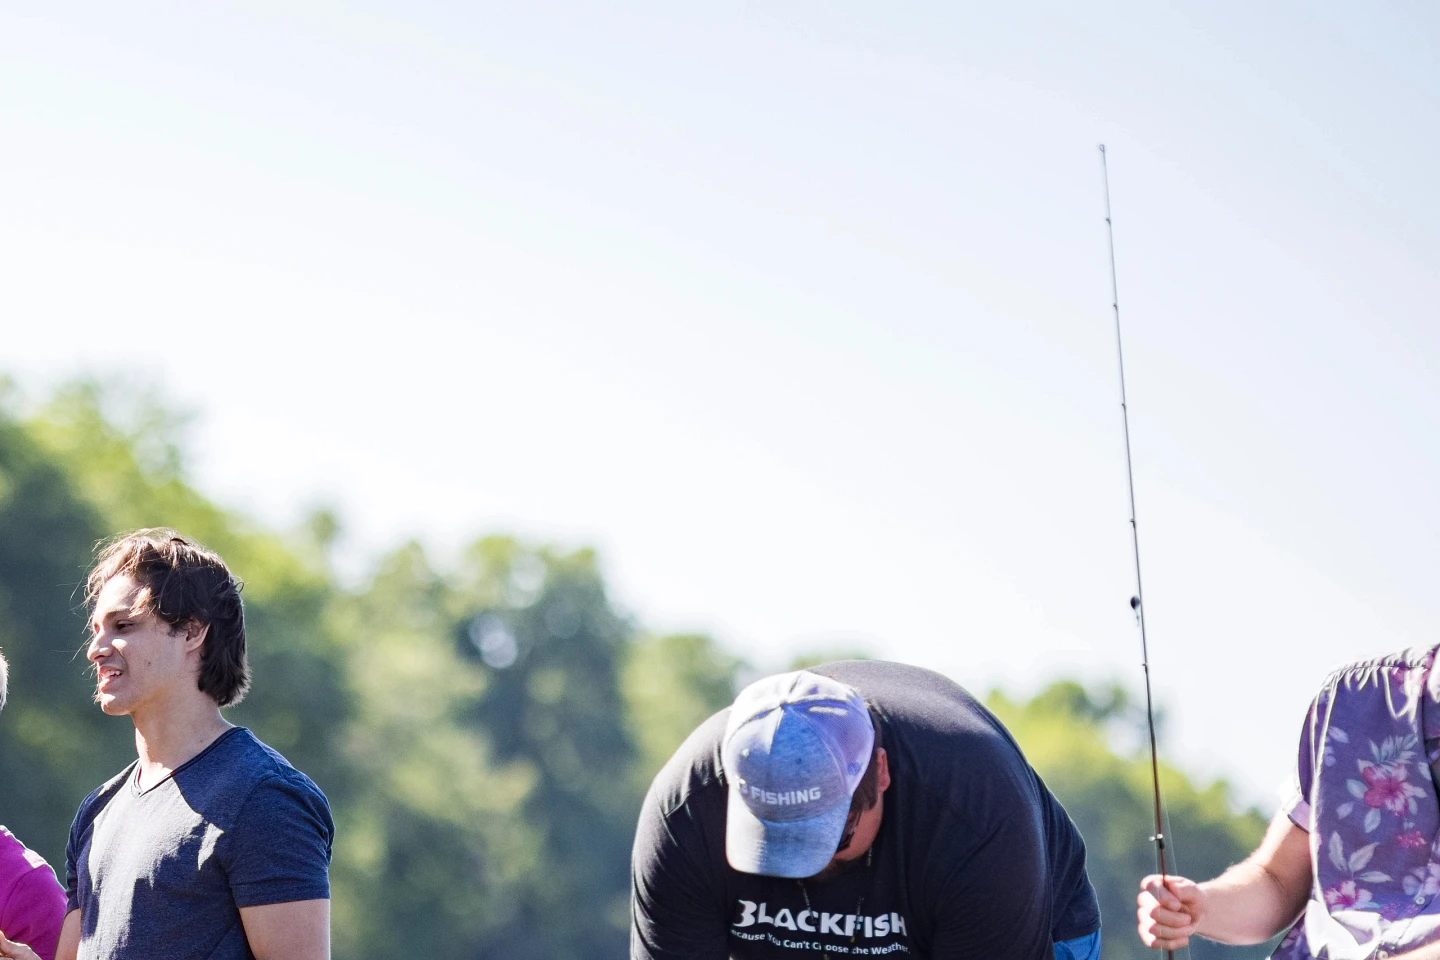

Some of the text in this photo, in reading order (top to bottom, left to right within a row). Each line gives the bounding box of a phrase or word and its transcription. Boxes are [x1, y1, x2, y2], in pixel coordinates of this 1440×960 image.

[750, 785, 821, 805] FISHING
[732, 899, 907, 938] BLACKFISH
[730, 929, 766, 941] ecause
[783, 939, 810, 950] Can't
